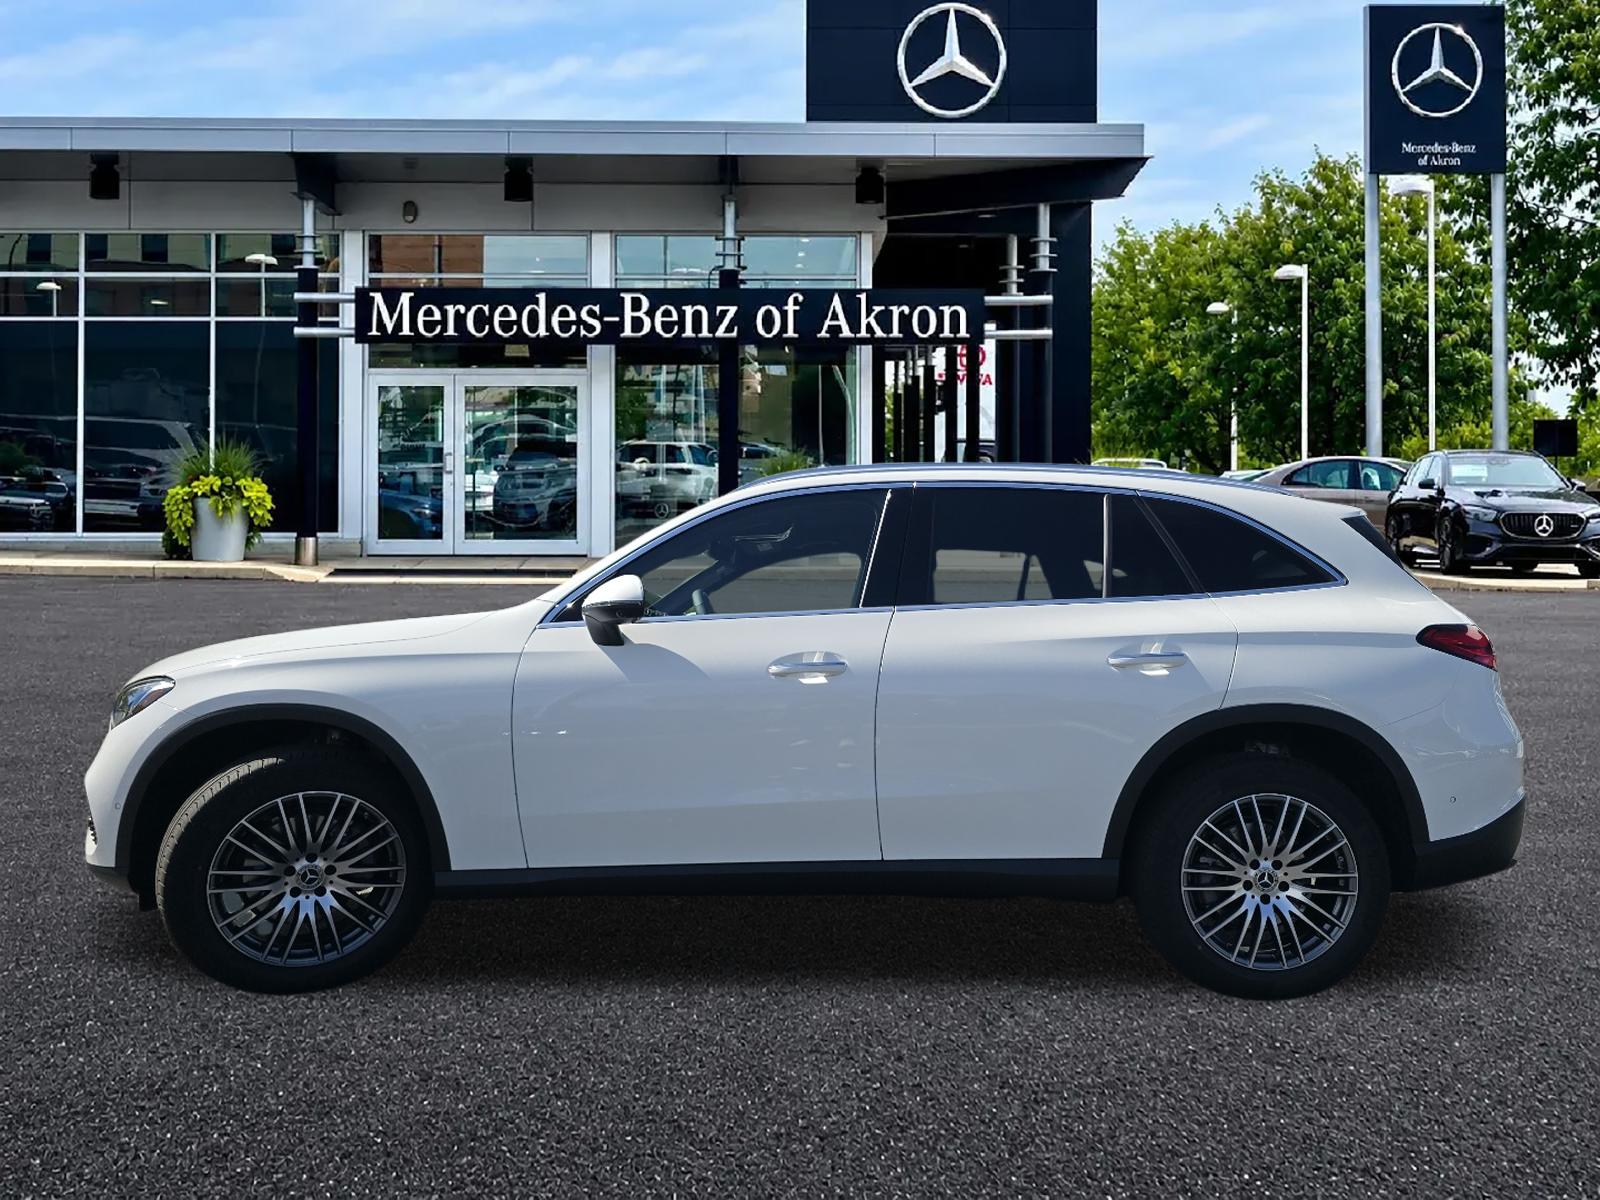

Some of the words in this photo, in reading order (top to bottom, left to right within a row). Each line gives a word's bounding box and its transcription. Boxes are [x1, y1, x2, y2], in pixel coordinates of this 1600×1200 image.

[1401, 142, 1477, 154] Mercedes-Benz
[1417, 154, 1429, 166] of
[1430, 154, 1461, 166] Akron
[367, 291, 738, 338] Mercedes-Benz
[755, 291, 804, 338] of
[816, 291, 971, 338] Akron
